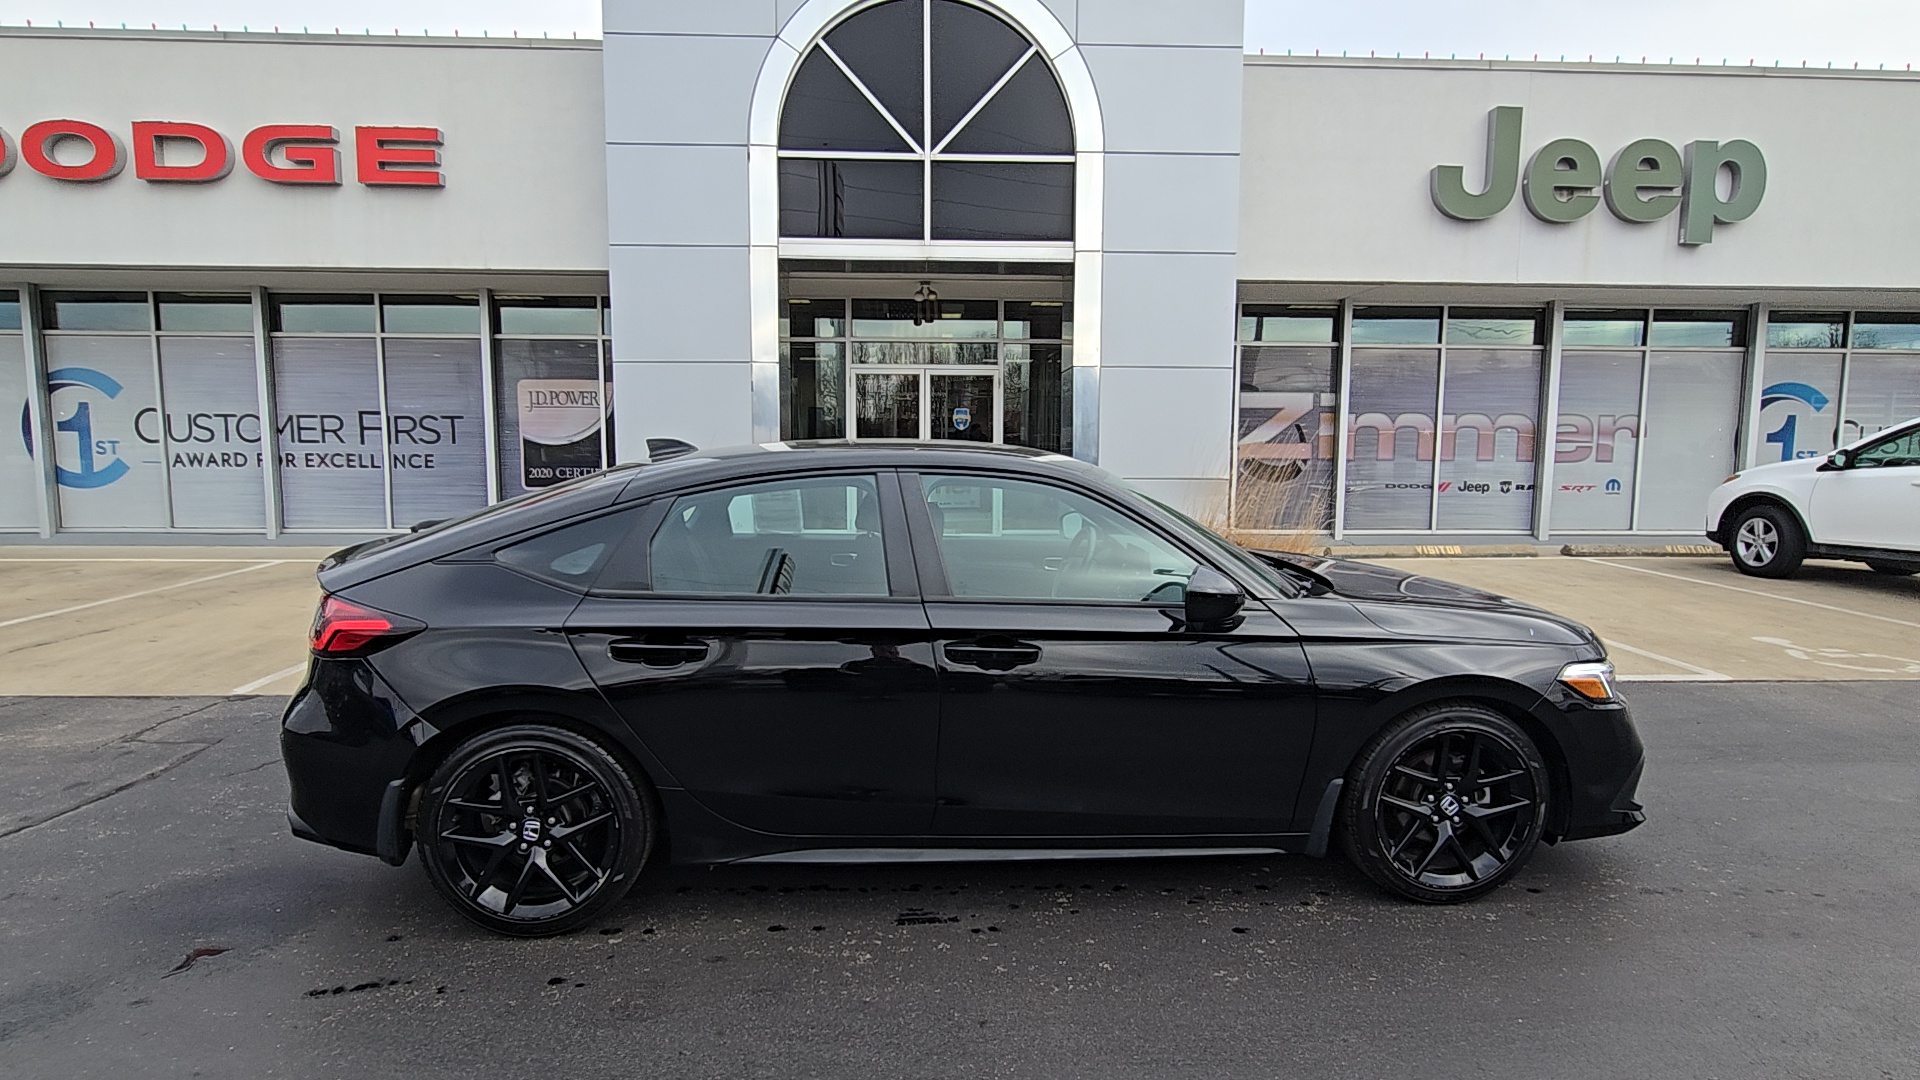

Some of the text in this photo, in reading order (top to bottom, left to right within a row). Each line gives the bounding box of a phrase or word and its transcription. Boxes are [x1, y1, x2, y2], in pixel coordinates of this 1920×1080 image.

[0, 118, 446, 188] ODGE
[1430, 105, 1767, 246] Jeep
[550, 391, 600, 406] POWER
[358, 410, 465, 445] FIRST
[1238, 392, 1648, 463] Zimmer
[172, 453, 248, 468] AWARD
[305, 453, 435, 469] EXCELLNCE
[528, 467, 553, 479] 2020
[1458, 481, 1490, 494] Jeep
[1558, 485, 1597, 493] SRT
[1415, 545, 1462, 555] VISITOR
[1665, 545, 1714, 554] VISITOR
